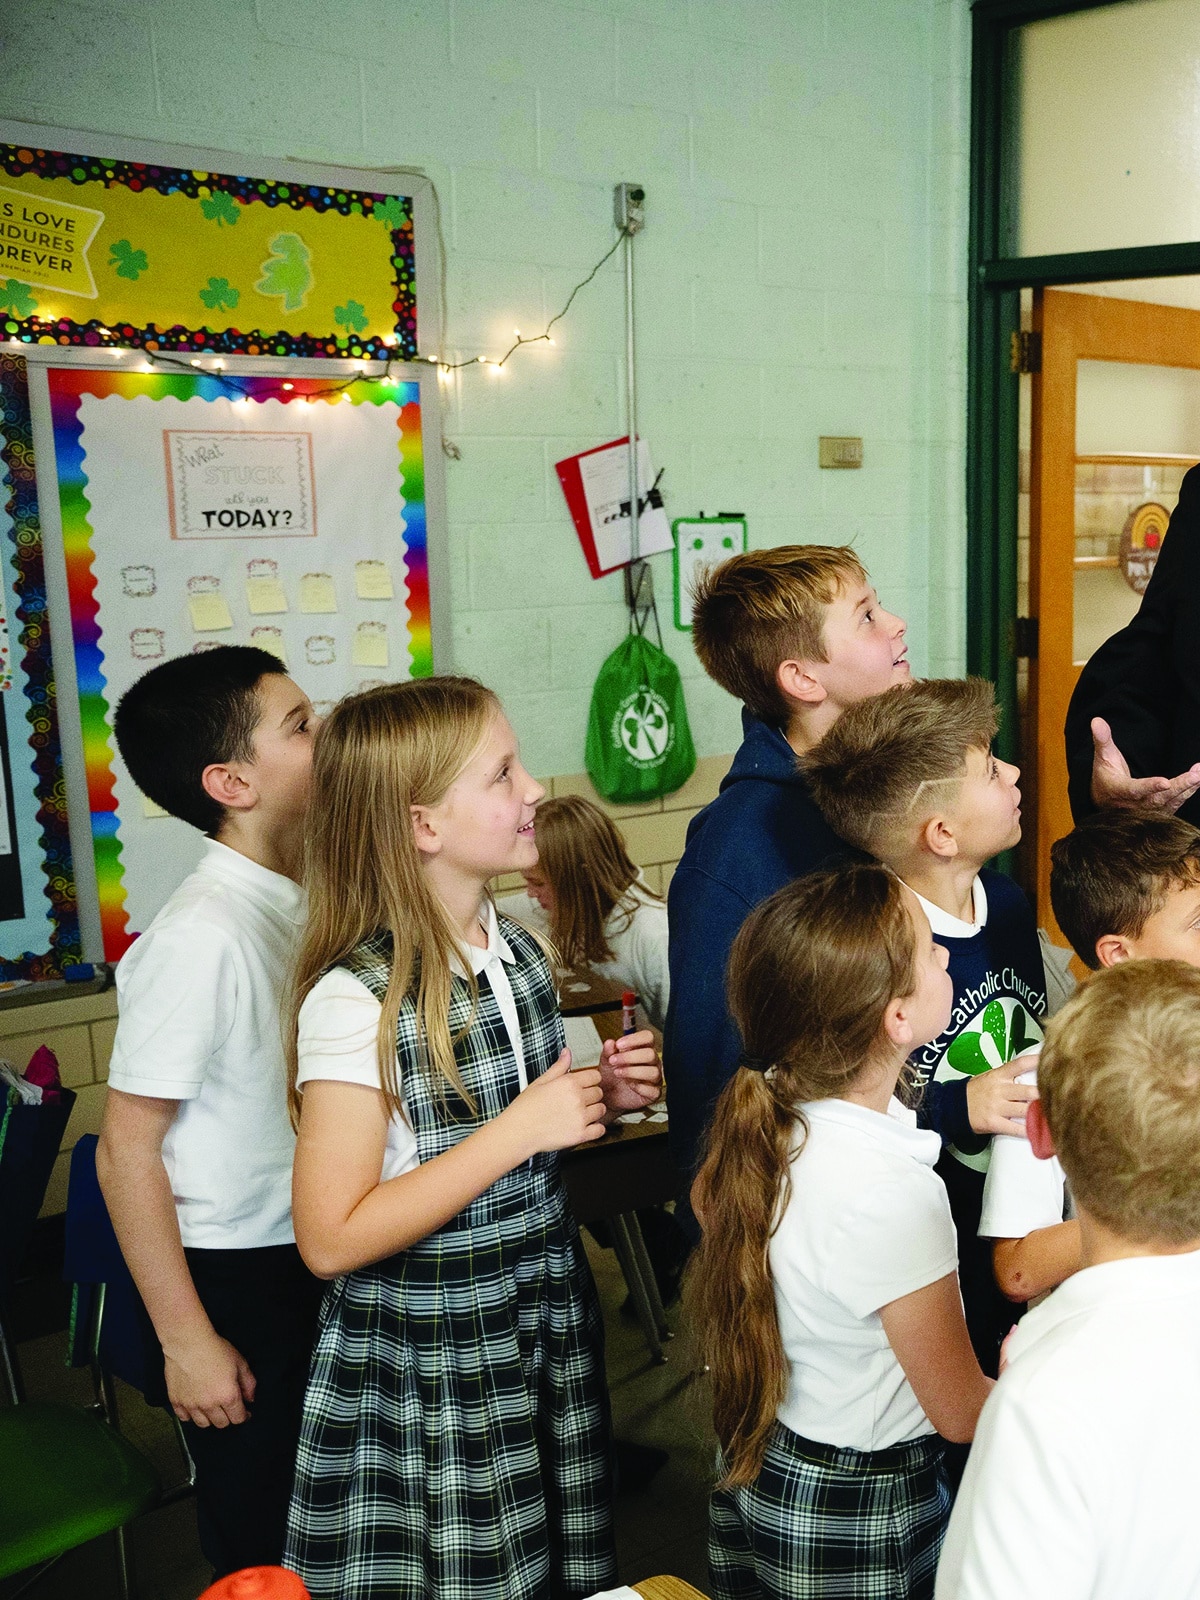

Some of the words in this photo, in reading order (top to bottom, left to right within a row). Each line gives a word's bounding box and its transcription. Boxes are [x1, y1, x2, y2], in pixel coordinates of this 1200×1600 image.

[22, 207, 76, 233] LOVE
[184, 443, 224, 468] What
[203, 465, 285, 486] STUCK
[201, 508, 293, 528] TODAY?
[943, 970, 1002, 1036] Catholic
[1002, 967, 1047, 1016] Church
